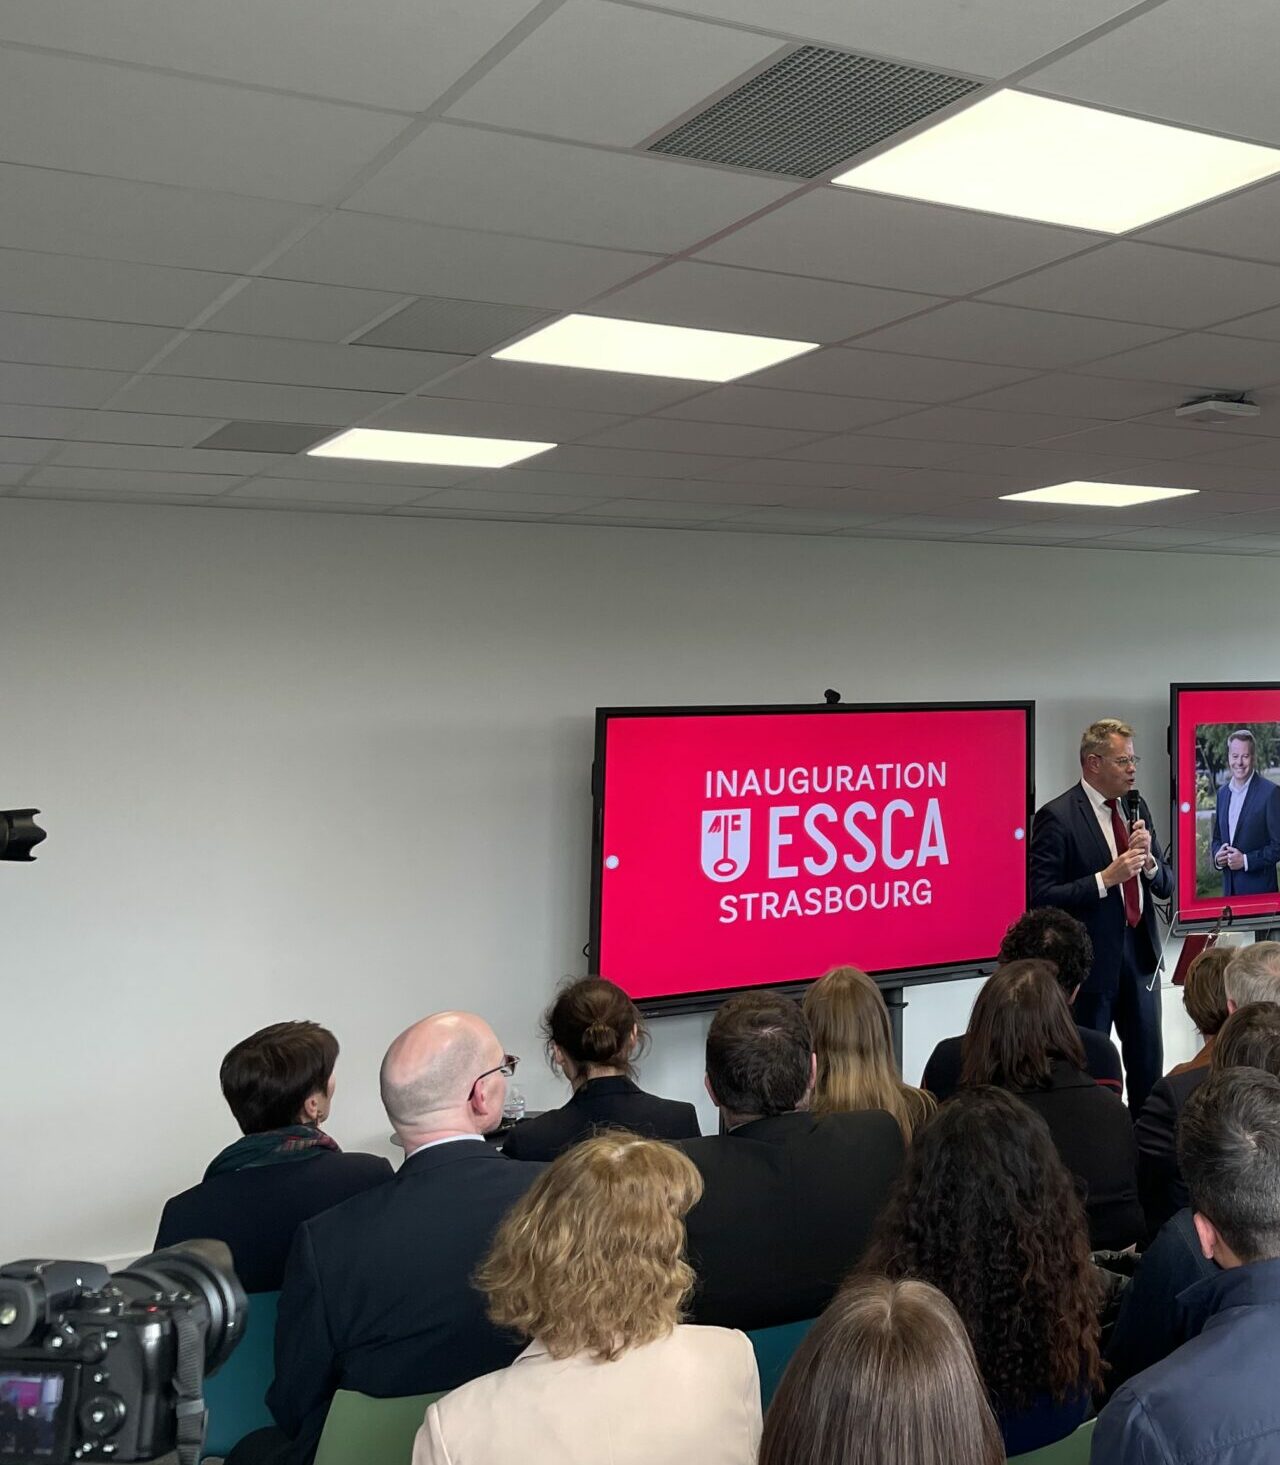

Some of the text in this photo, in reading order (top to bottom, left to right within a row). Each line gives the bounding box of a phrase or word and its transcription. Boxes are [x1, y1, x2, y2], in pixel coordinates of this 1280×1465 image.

[705, 762, 946, 798] INAUGURATION
[768, 798, 949, 878] ESSCA
[719, 879, 932, 923] STRASBOURG
